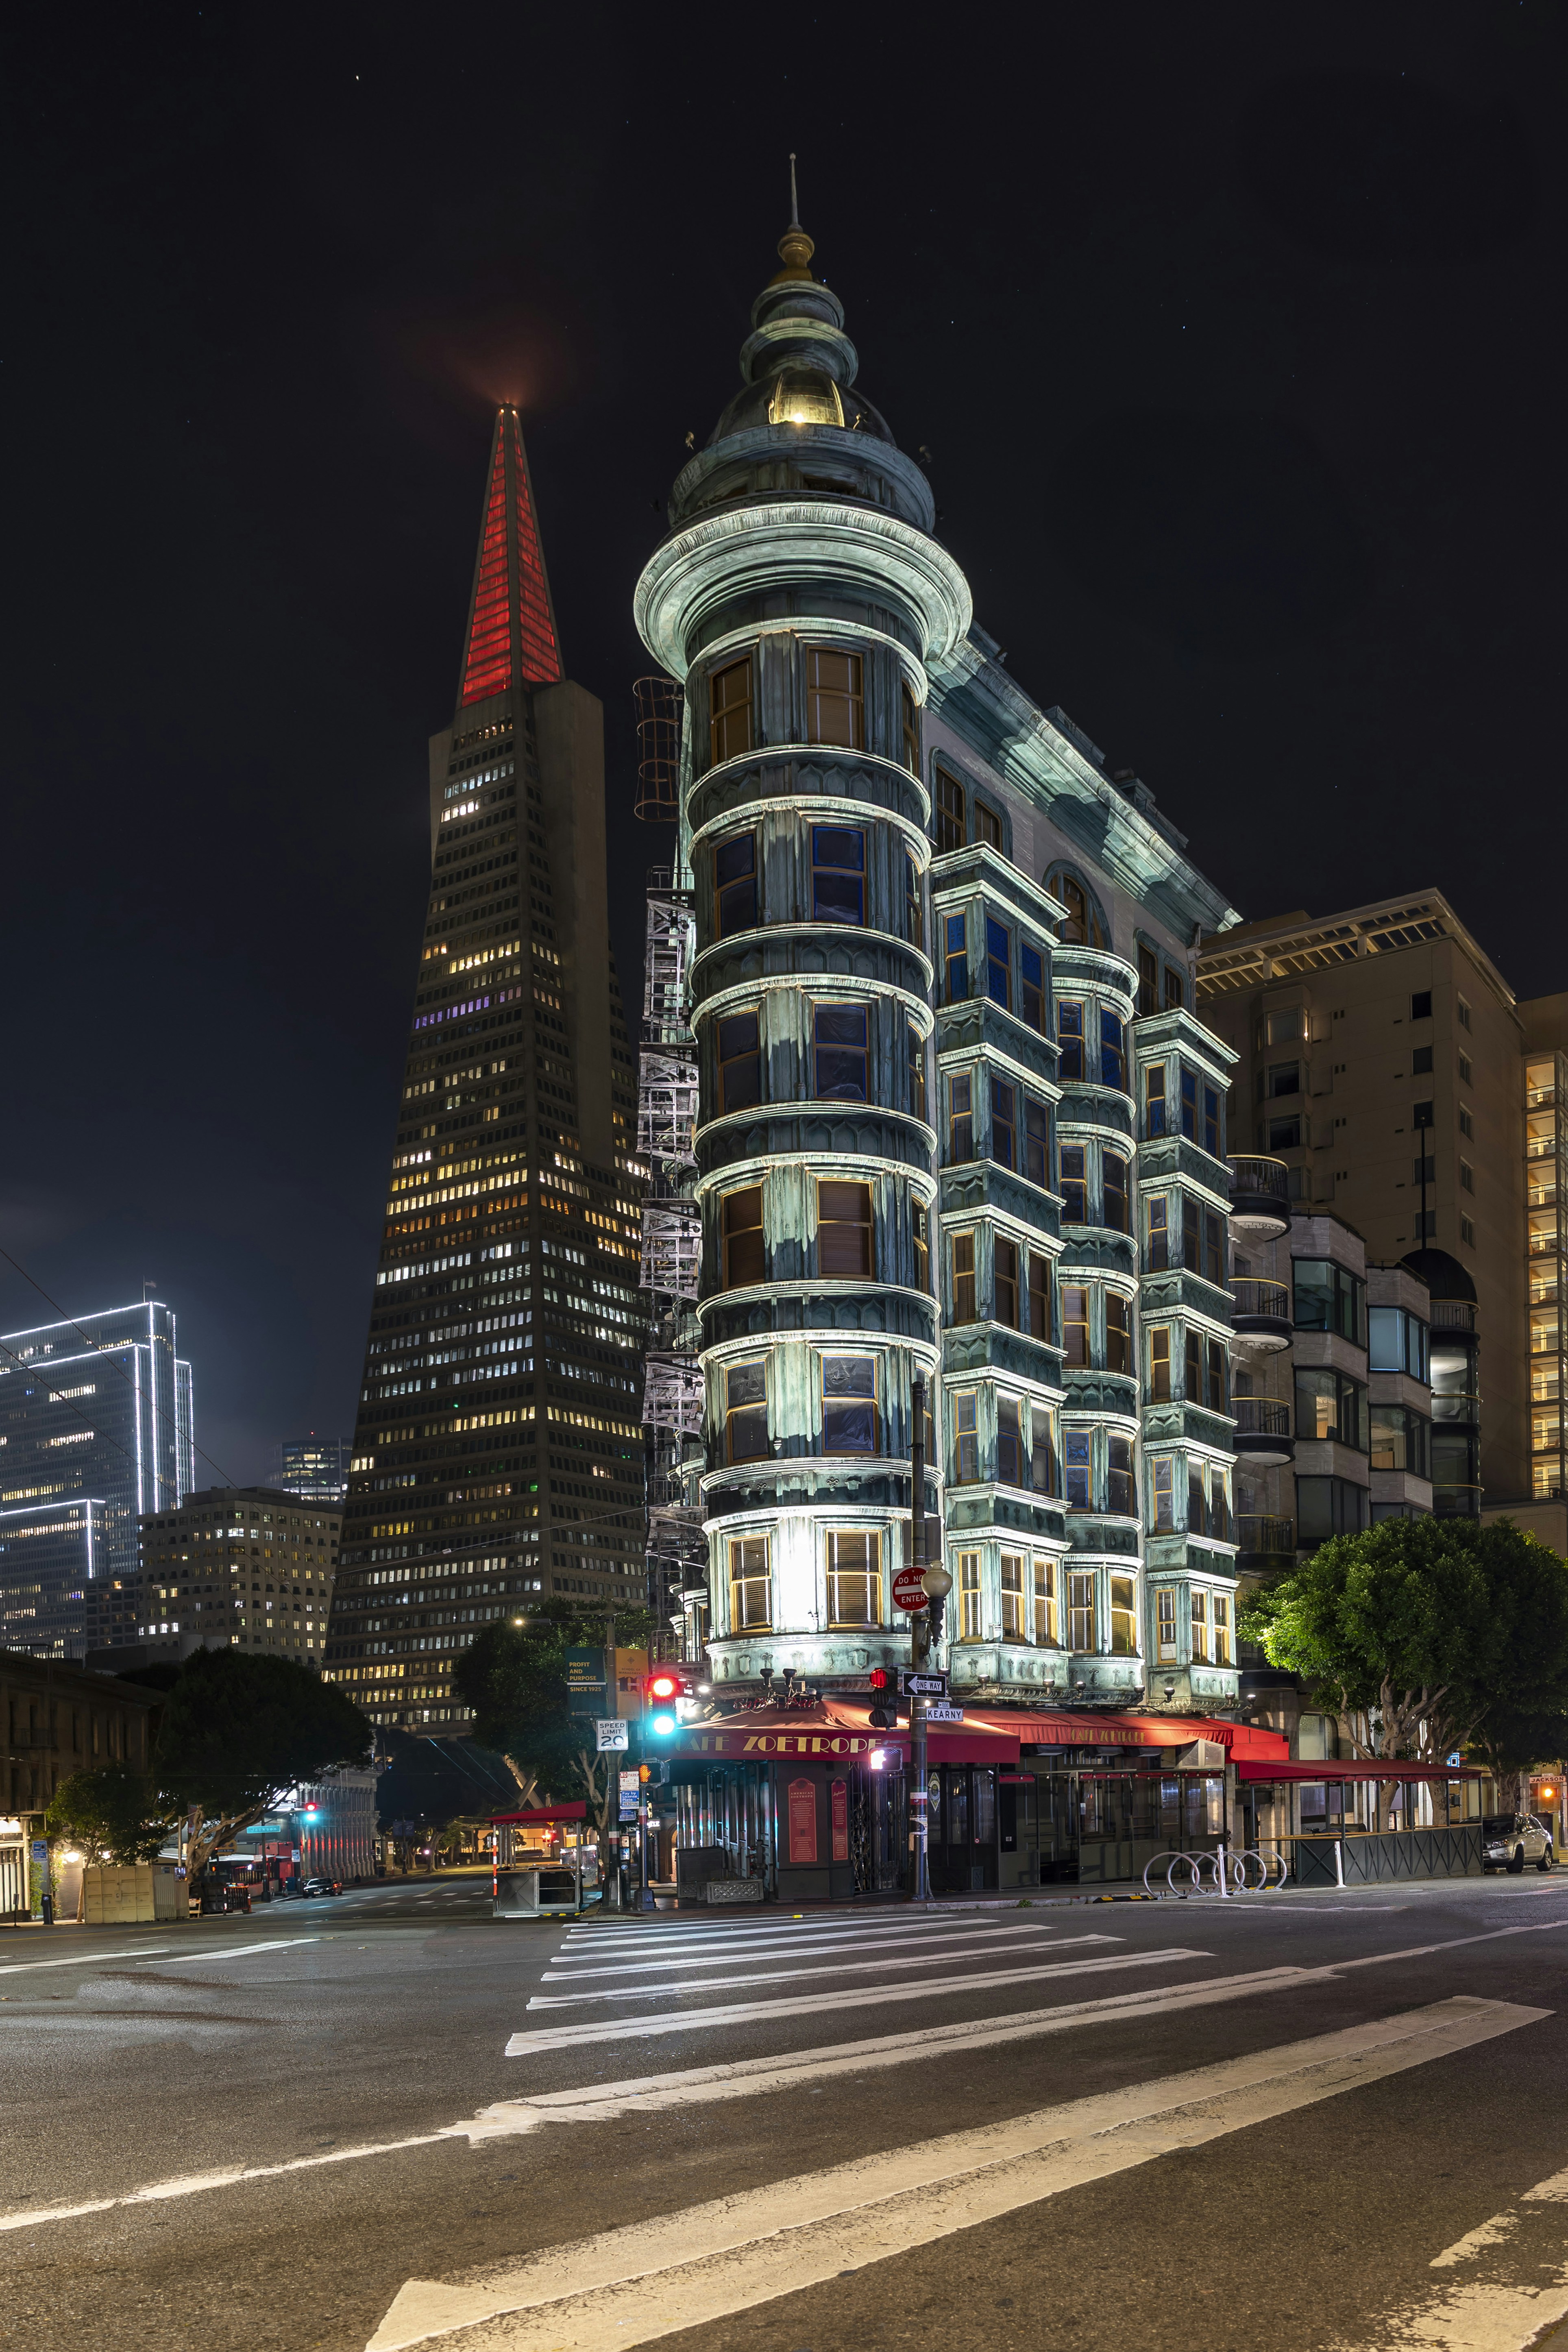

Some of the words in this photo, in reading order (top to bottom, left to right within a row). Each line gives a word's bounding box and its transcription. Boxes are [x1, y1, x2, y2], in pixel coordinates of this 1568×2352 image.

[902, 1594, 925, 1603] ENTER
[928, 1710, 961, 1719] KEARNY
[601, 1736, 624, 1747] 20
[1071, 1729, 1095, 1741] CAFE
[1100, 1730, 1146, 1743] ZOETROPE
[675, 1736, 730, 1752] CAFE
[743, 1736, 882, 1753] ZOETROPE
